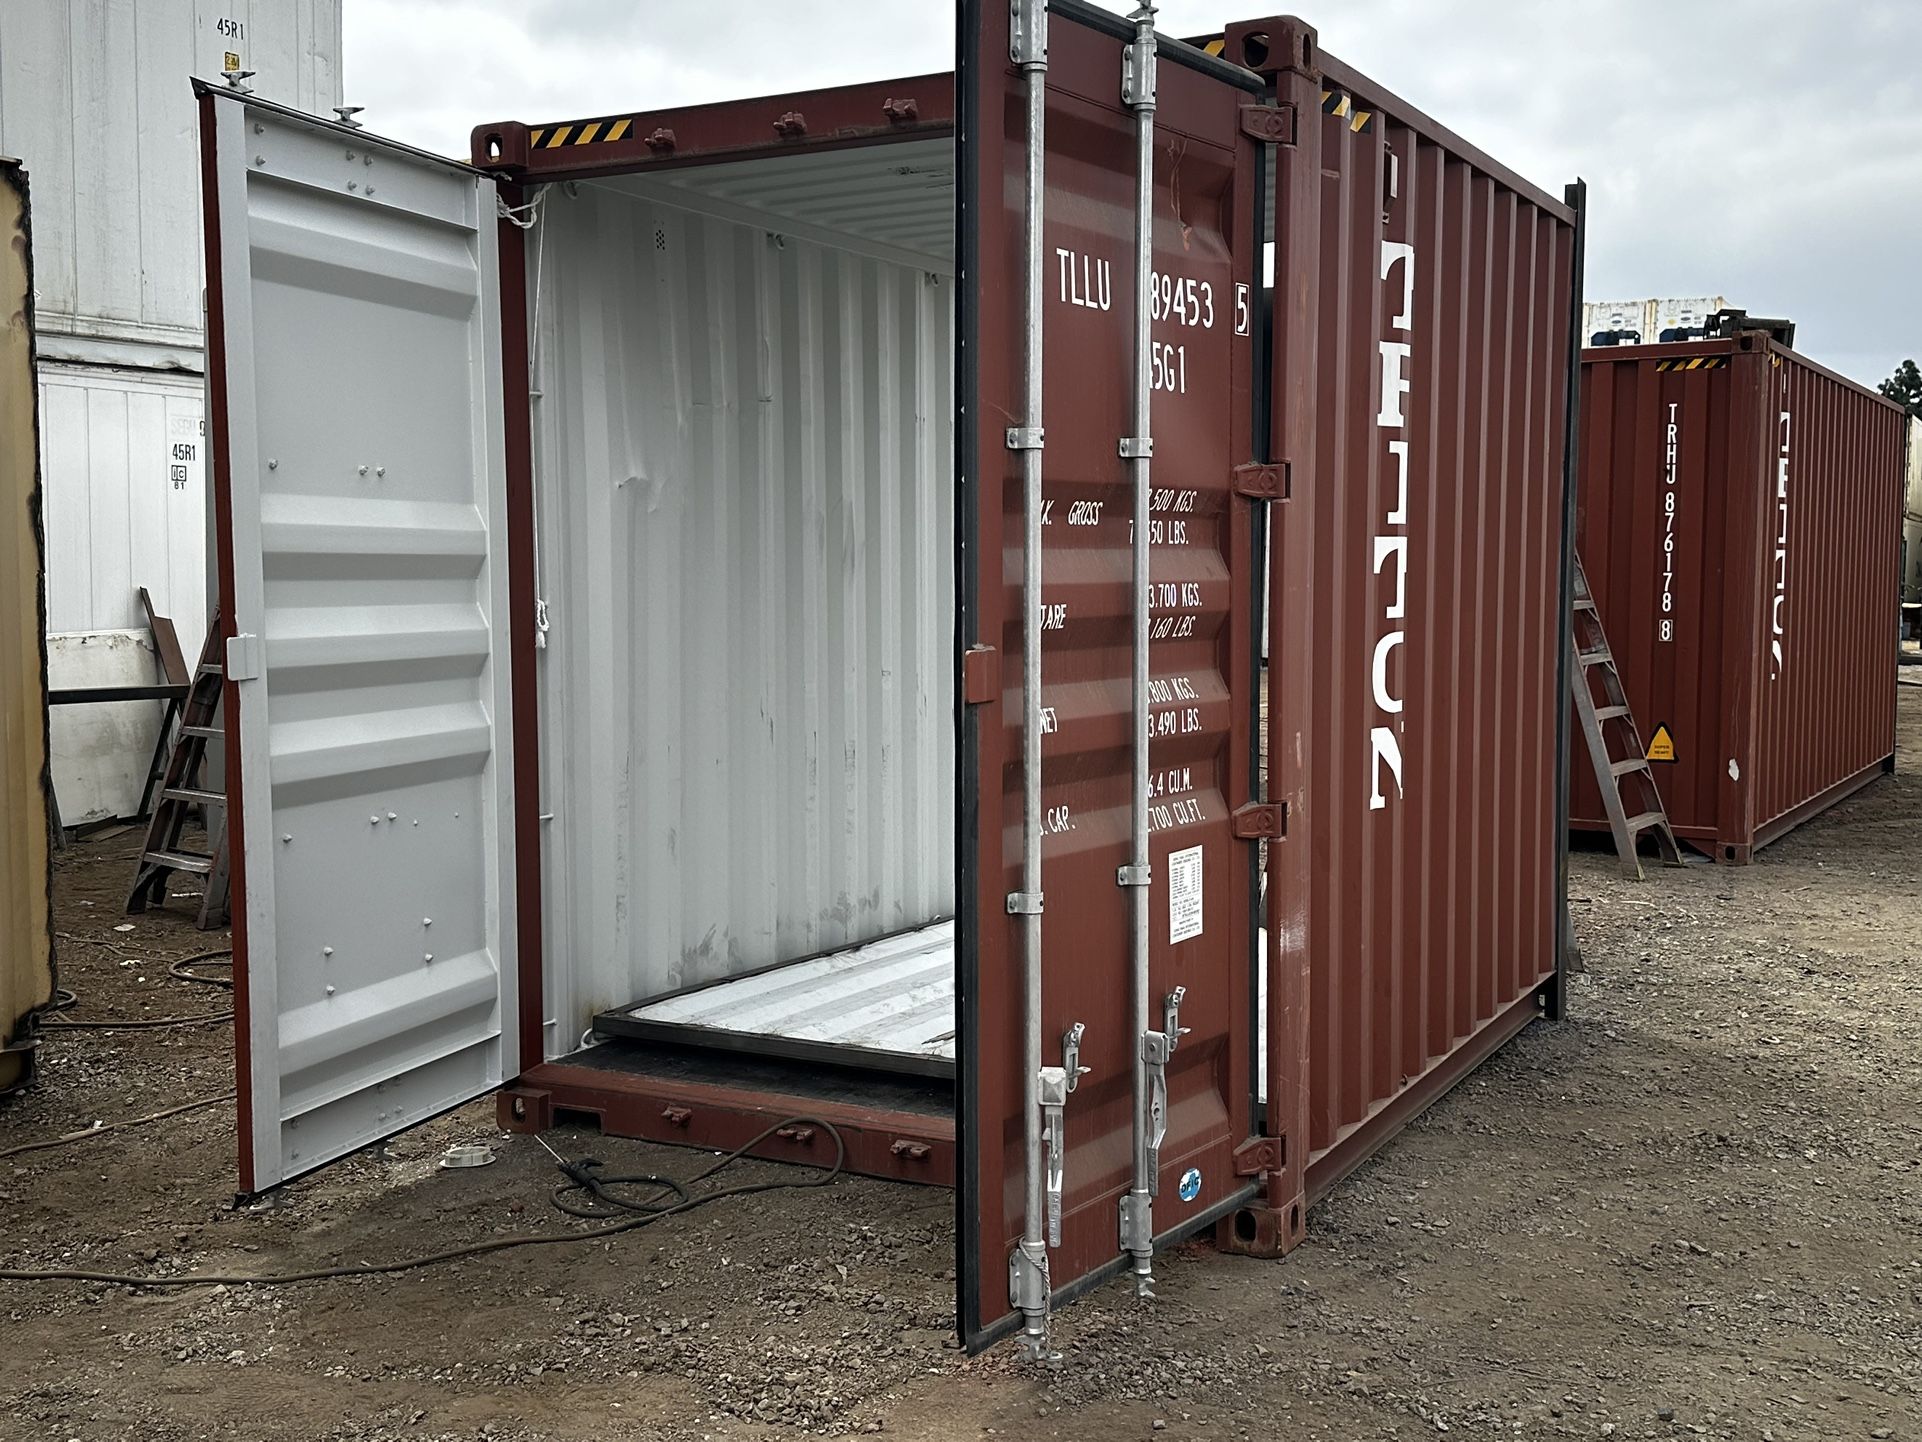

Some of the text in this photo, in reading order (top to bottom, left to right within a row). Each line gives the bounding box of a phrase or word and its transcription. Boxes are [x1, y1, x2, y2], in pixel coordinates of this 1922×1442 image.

[217, 17, 244, 40] 45R1
[1056, 247, 1111, 311] TLLU
[1236, 284, 1248, 334] 5
[1150, 341, 1185, 394] 5G1
[172, 443, 196, 461] 45R1
[1068, 500, 1103, 526] GROSS
[1173, 490, 1198, 512] KGS.
[1168, 520, 1189, 544] LBS.
[1660, 403, 1677, 640] TRHU 876178 8
[1181, 583, 1202, 607] KGS.
[1172, 616, 1196, 637] LBS.
[1171, 677, 1199, 700] KGS.
[1182, 708, 1202, 733] LBS.
[1047, 805, 1076, 833] CAP.
